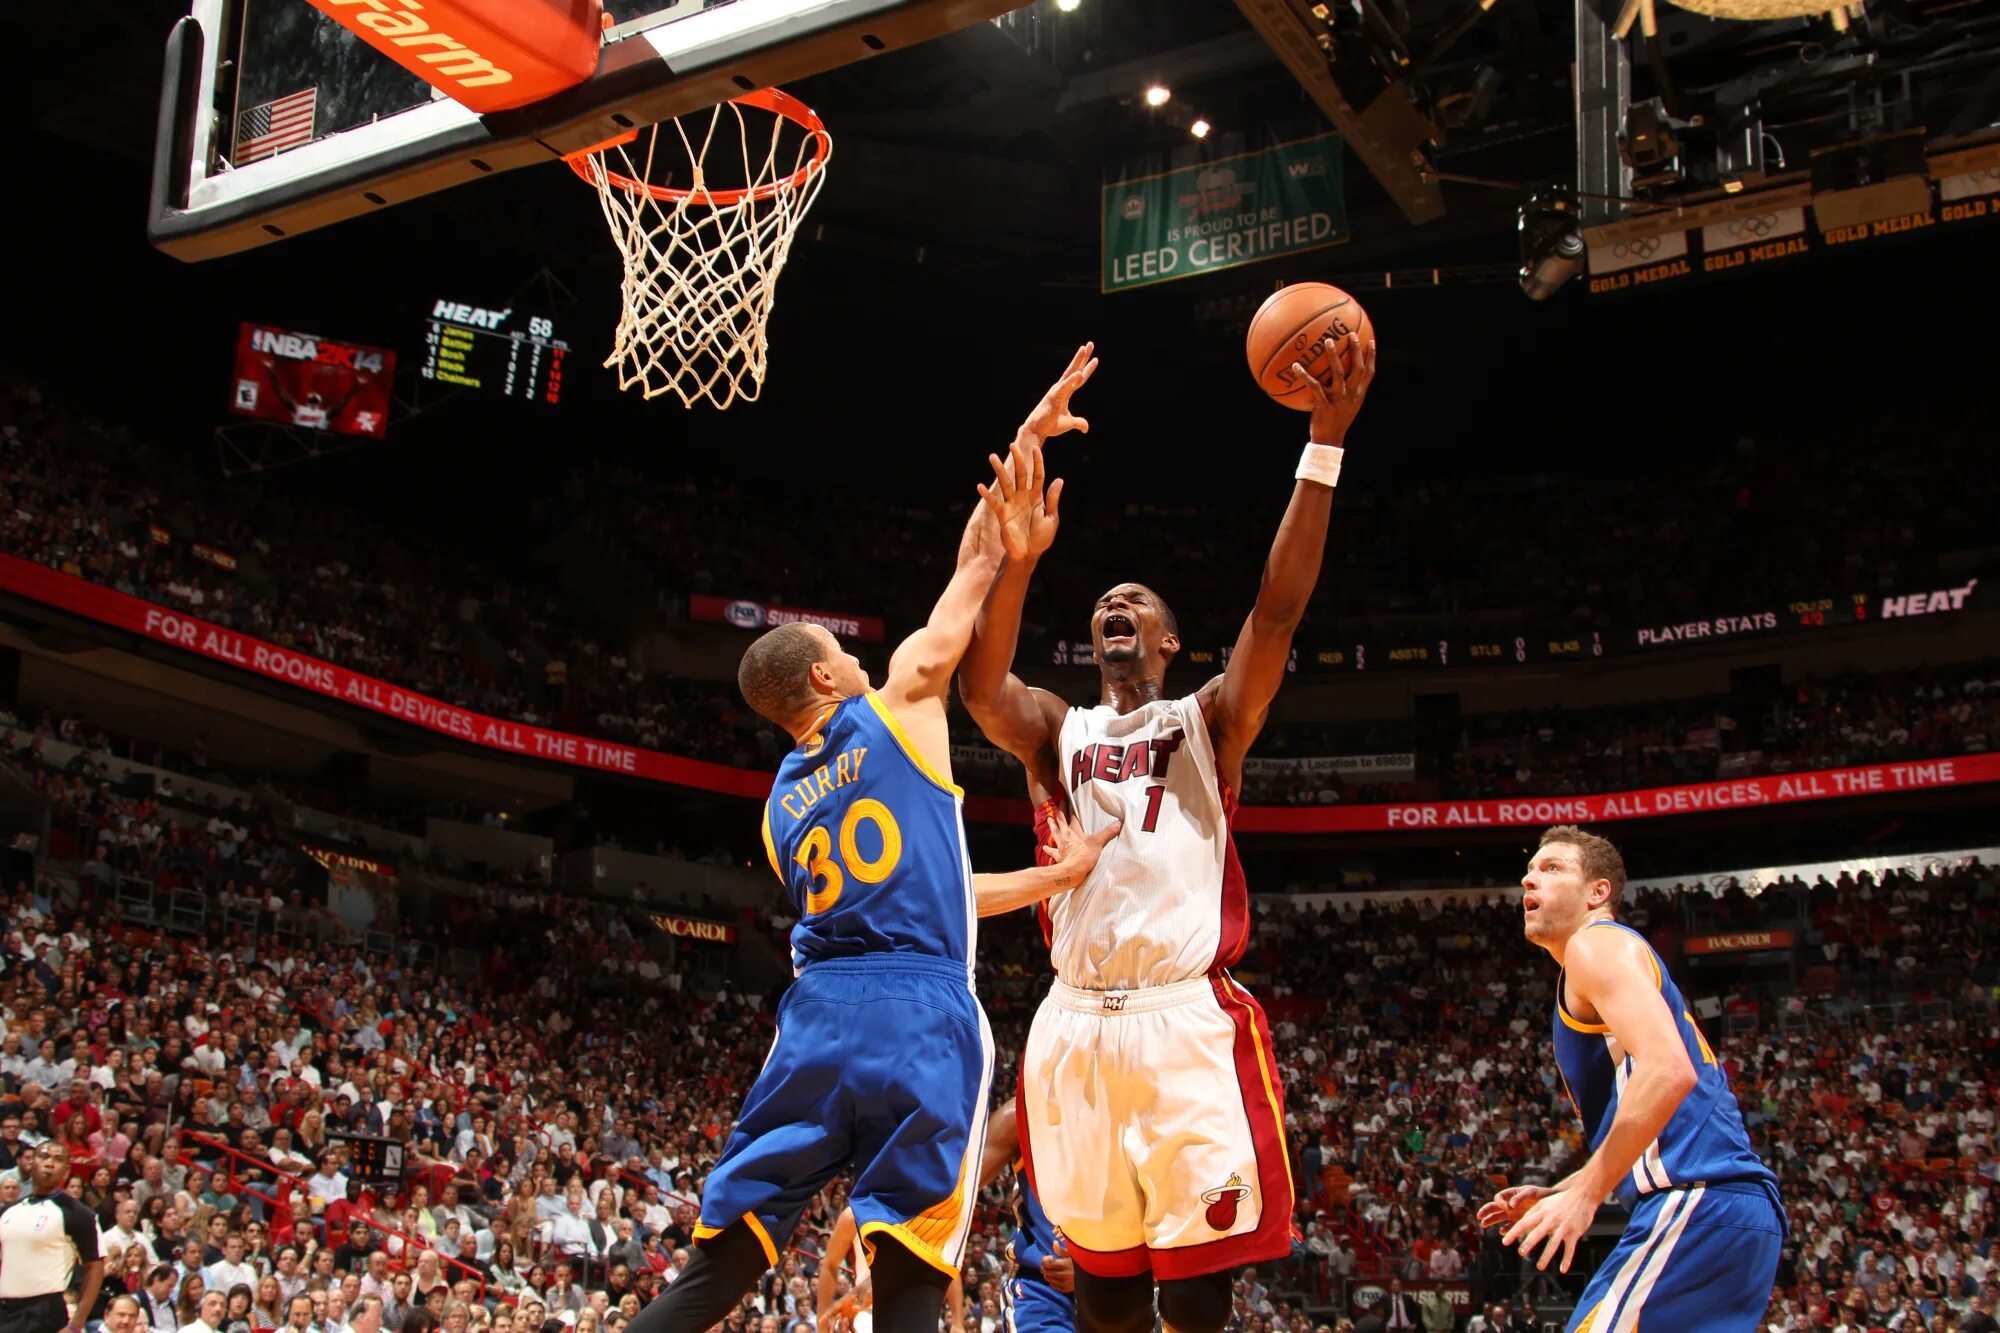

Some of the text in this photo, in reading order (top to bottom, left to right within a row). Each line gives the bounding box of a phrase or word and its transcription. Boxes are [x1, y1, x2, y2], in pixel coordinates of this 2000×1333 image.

[1167, 207, 1278, 243] IS PROUD TO BE
[1825, 211, 1935, 246] GOLD MEDAL
[1941, 199, 1988, 222] GOLD
[1113, 247, 1179, 284] LEED
[1704, 237, 1809, 272] GOLD MEDAL
[1590, 258, 1692, 294] GOLD MEDAL
[433, 299, 553, 338] HEAT 58
[263, 331, 318, 361] NBA
[1881, 578, 1978, 619] HEAT
[1638, 612, 1778, 645] PLAYER STATS
[145, 609, 637, 772] FOR ALL ROOMS, ALL DEVICES, ALL THE TIME
[1071, 727, 1186, 793] HEAT
[1308, 759, 1358, 770] Location
[1361, 758, 1372, 768] to
[780, 747, 868, 820] CURRY
[1387, 762, 1956, 827] FOR ALL ROOMS, ALL DEVICES, ALL THE TIME
[1141, 785, 1166, 833] 1
[793, 798, 902, 914] 30
[1708, 932, 1771, 949] BACARDI
